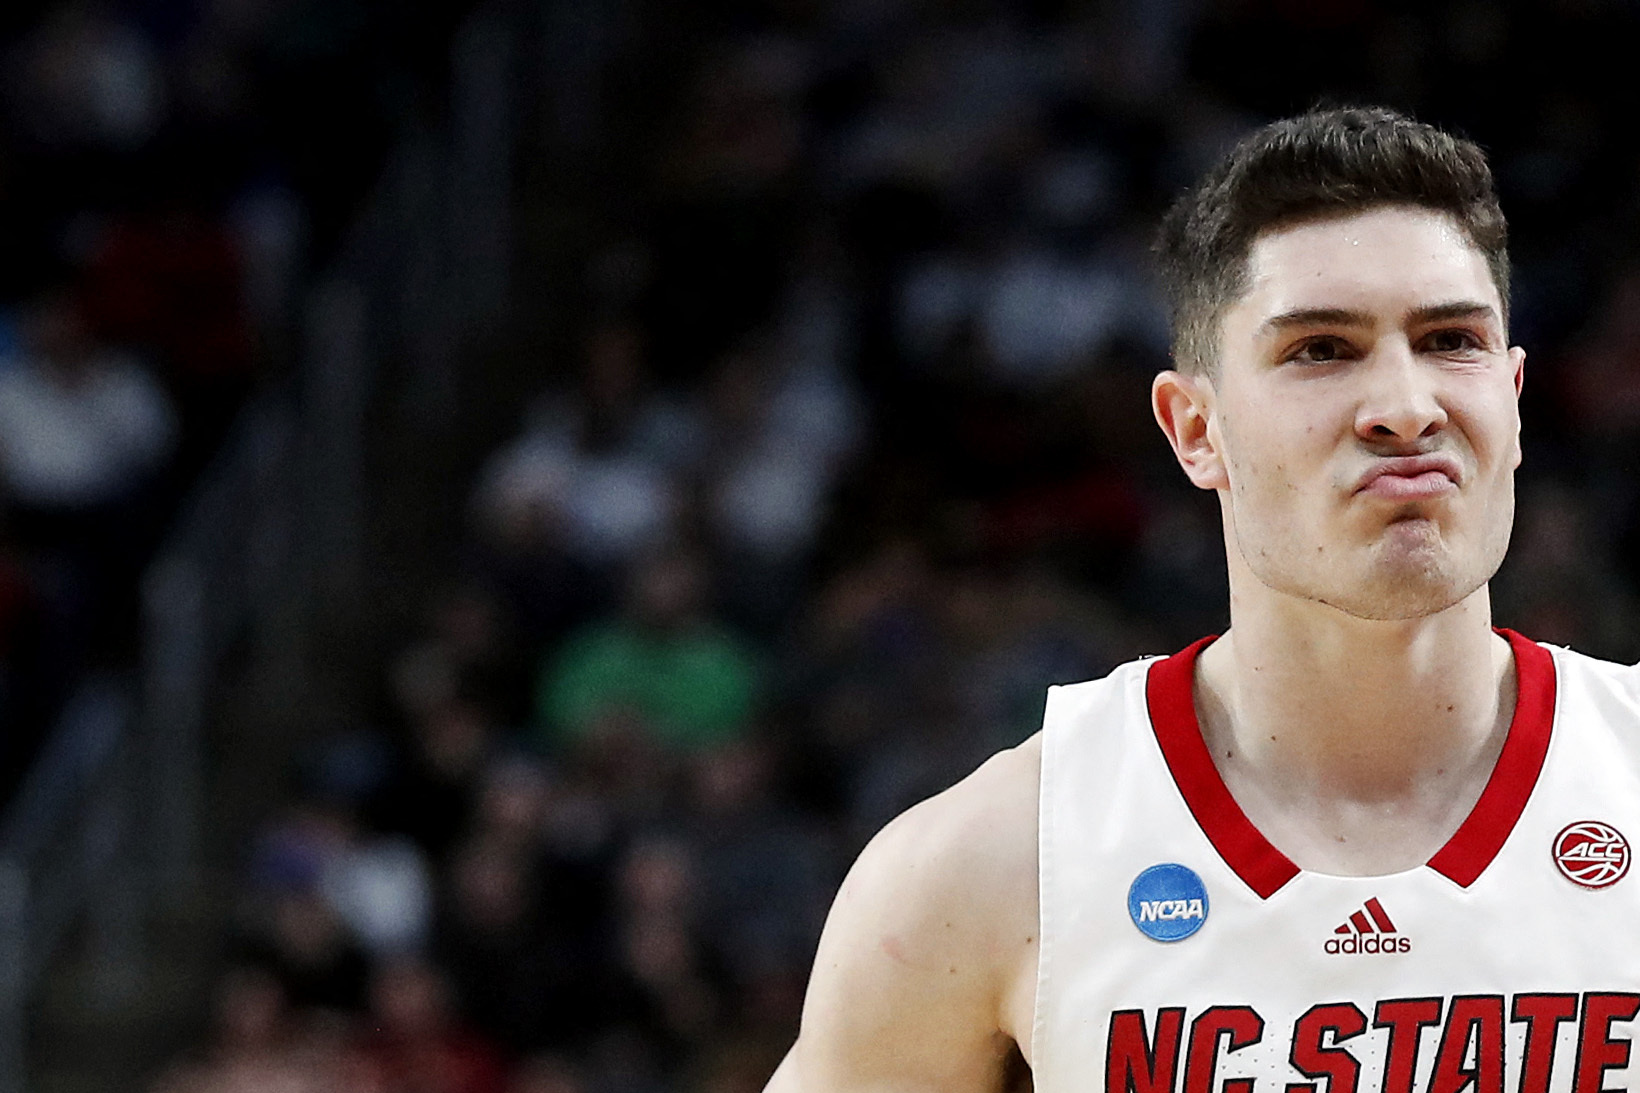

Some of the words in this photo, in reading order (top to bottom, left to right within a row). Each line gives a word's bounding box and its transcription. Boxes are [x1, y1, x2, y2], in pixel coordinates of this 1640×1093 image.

[1560, 841, 1626, 860] ACC
[1139, 898, 1204, 923] NCAA
[1323, 932, 1411, 955] adidas
